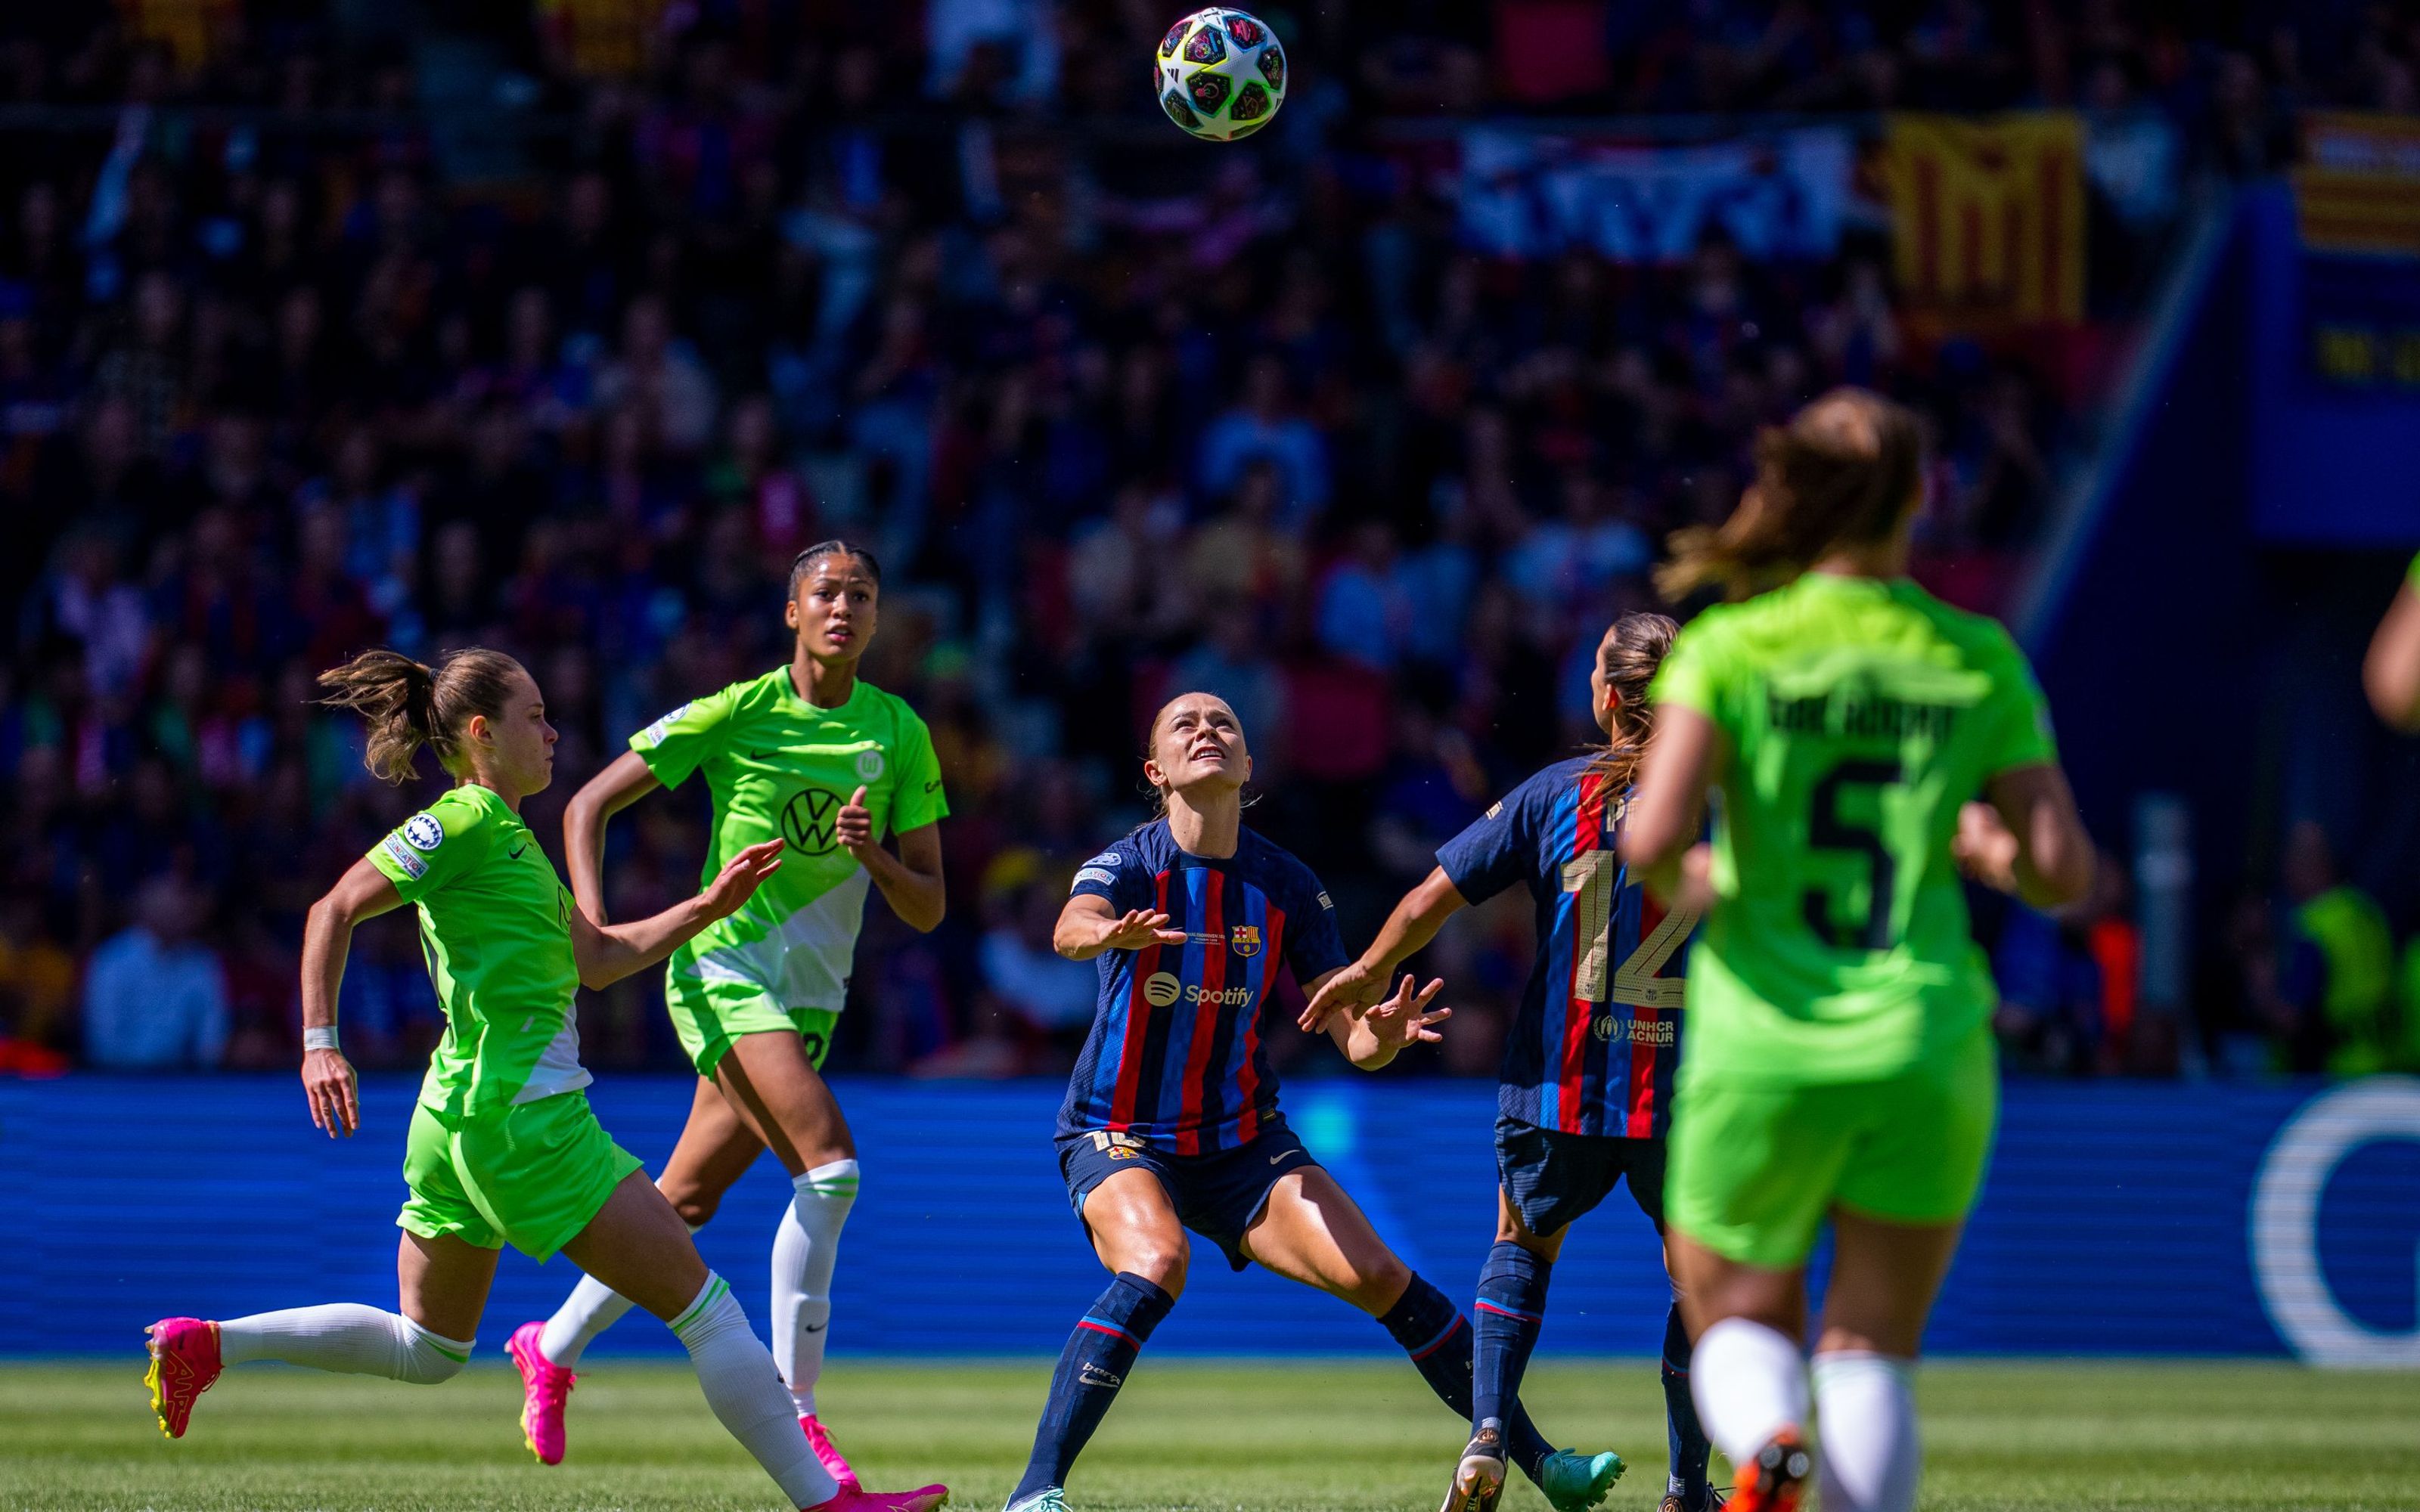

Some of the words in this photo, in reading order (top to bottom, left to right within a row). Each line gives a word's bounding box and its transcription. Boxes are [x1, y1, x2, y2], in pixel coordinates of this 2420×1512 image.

[1804, 761, 1906, 952] 5
[1184, 984, 1255, 1008] Spotify
[1627, 1018, 1674, 1032] UNHCR
[1627, 1030, 1674, 1043] ACNUR
